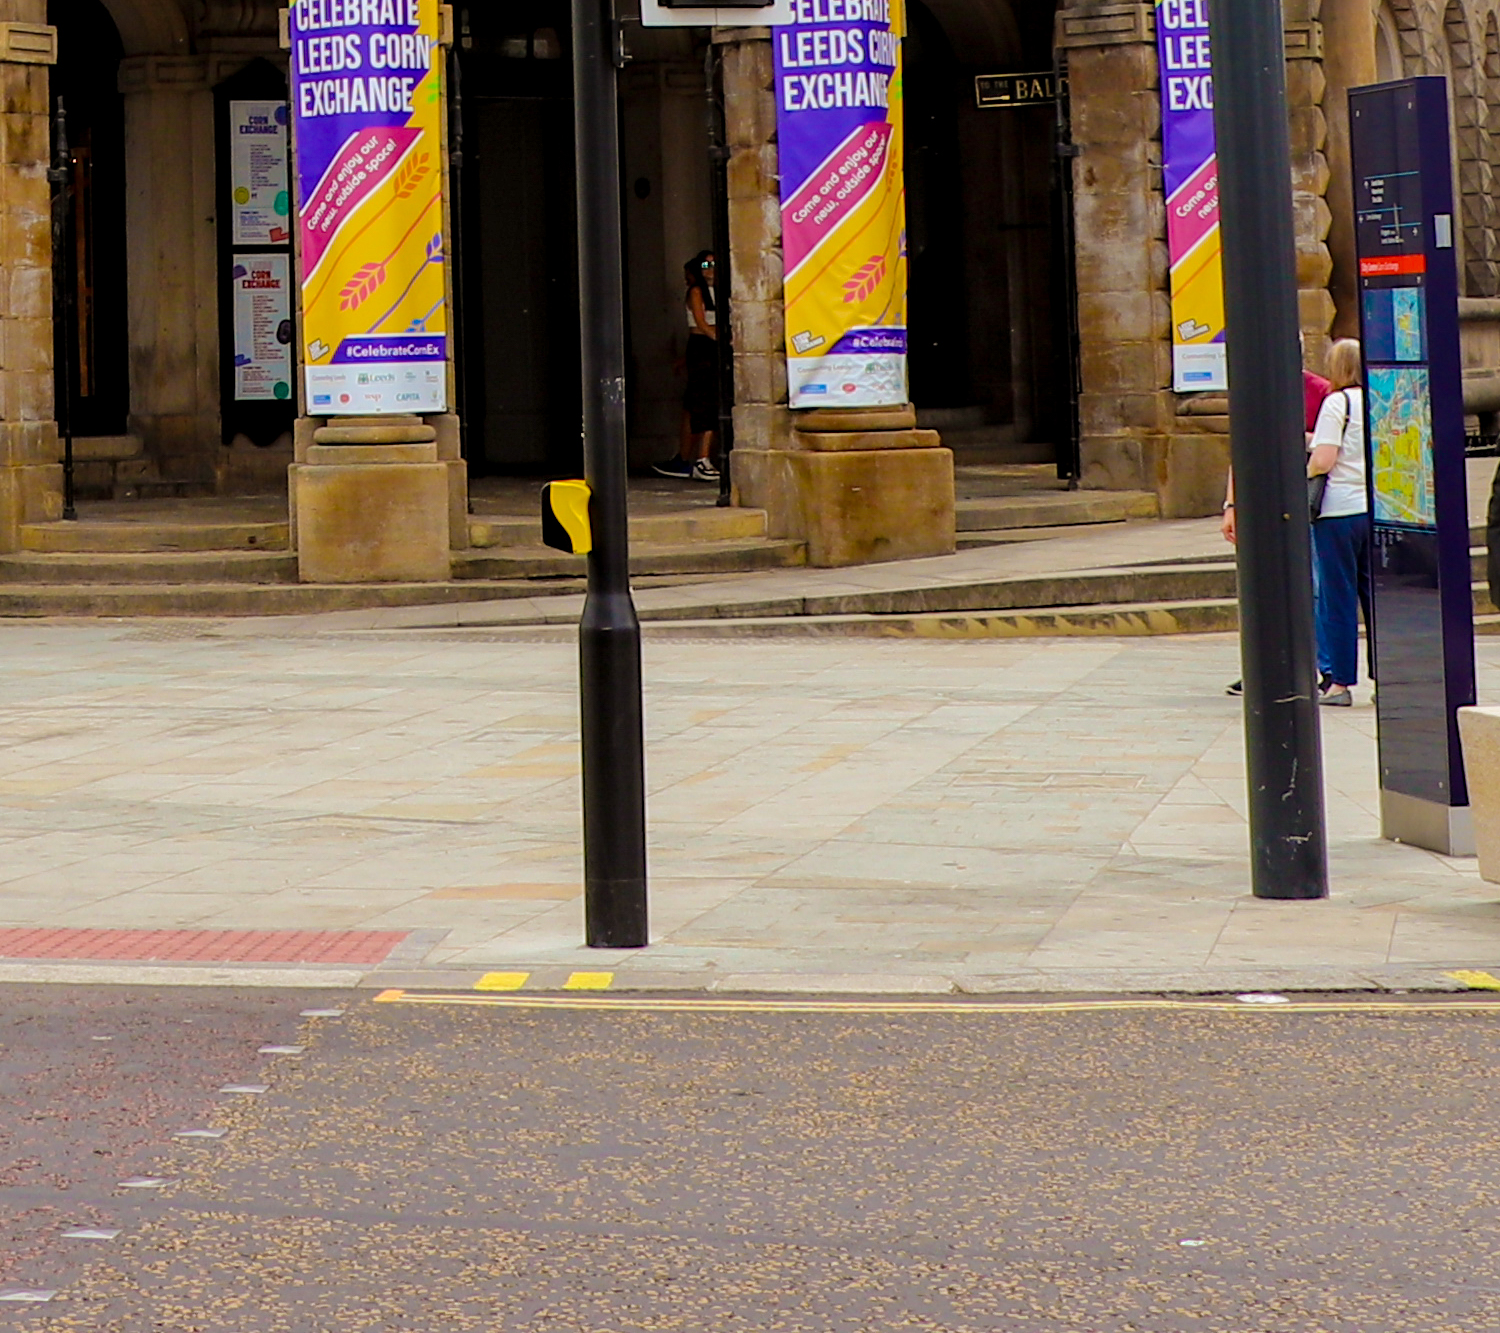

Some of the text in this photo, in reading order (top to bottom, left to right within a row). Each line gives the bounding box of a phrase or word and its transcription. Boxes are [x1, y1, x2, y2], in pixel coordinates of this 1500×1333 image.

[297, 33, 430, 75] LEEDS CORN
[781, 29, 864, 68] LEEDS
[300, 77, 414, 118] EXCHANGE
[306, 202, 327, 231] Come
[337, 153, 364, 181] enjoy
[360, 136, 379, 154] our
[335, 170, 367, 207] outside
[364, 138, 397, 172] space!
[791, 131, 879, 224] Come and enjoy our
[836, 164, 871, 201] outside
[1175, 190, 1206, 218] Come
[346, 344, 440, 357] #CelebrateCornEx
[369, 373, 395, 382] Leeds
[396, 393, 420, 402] CAPITA
